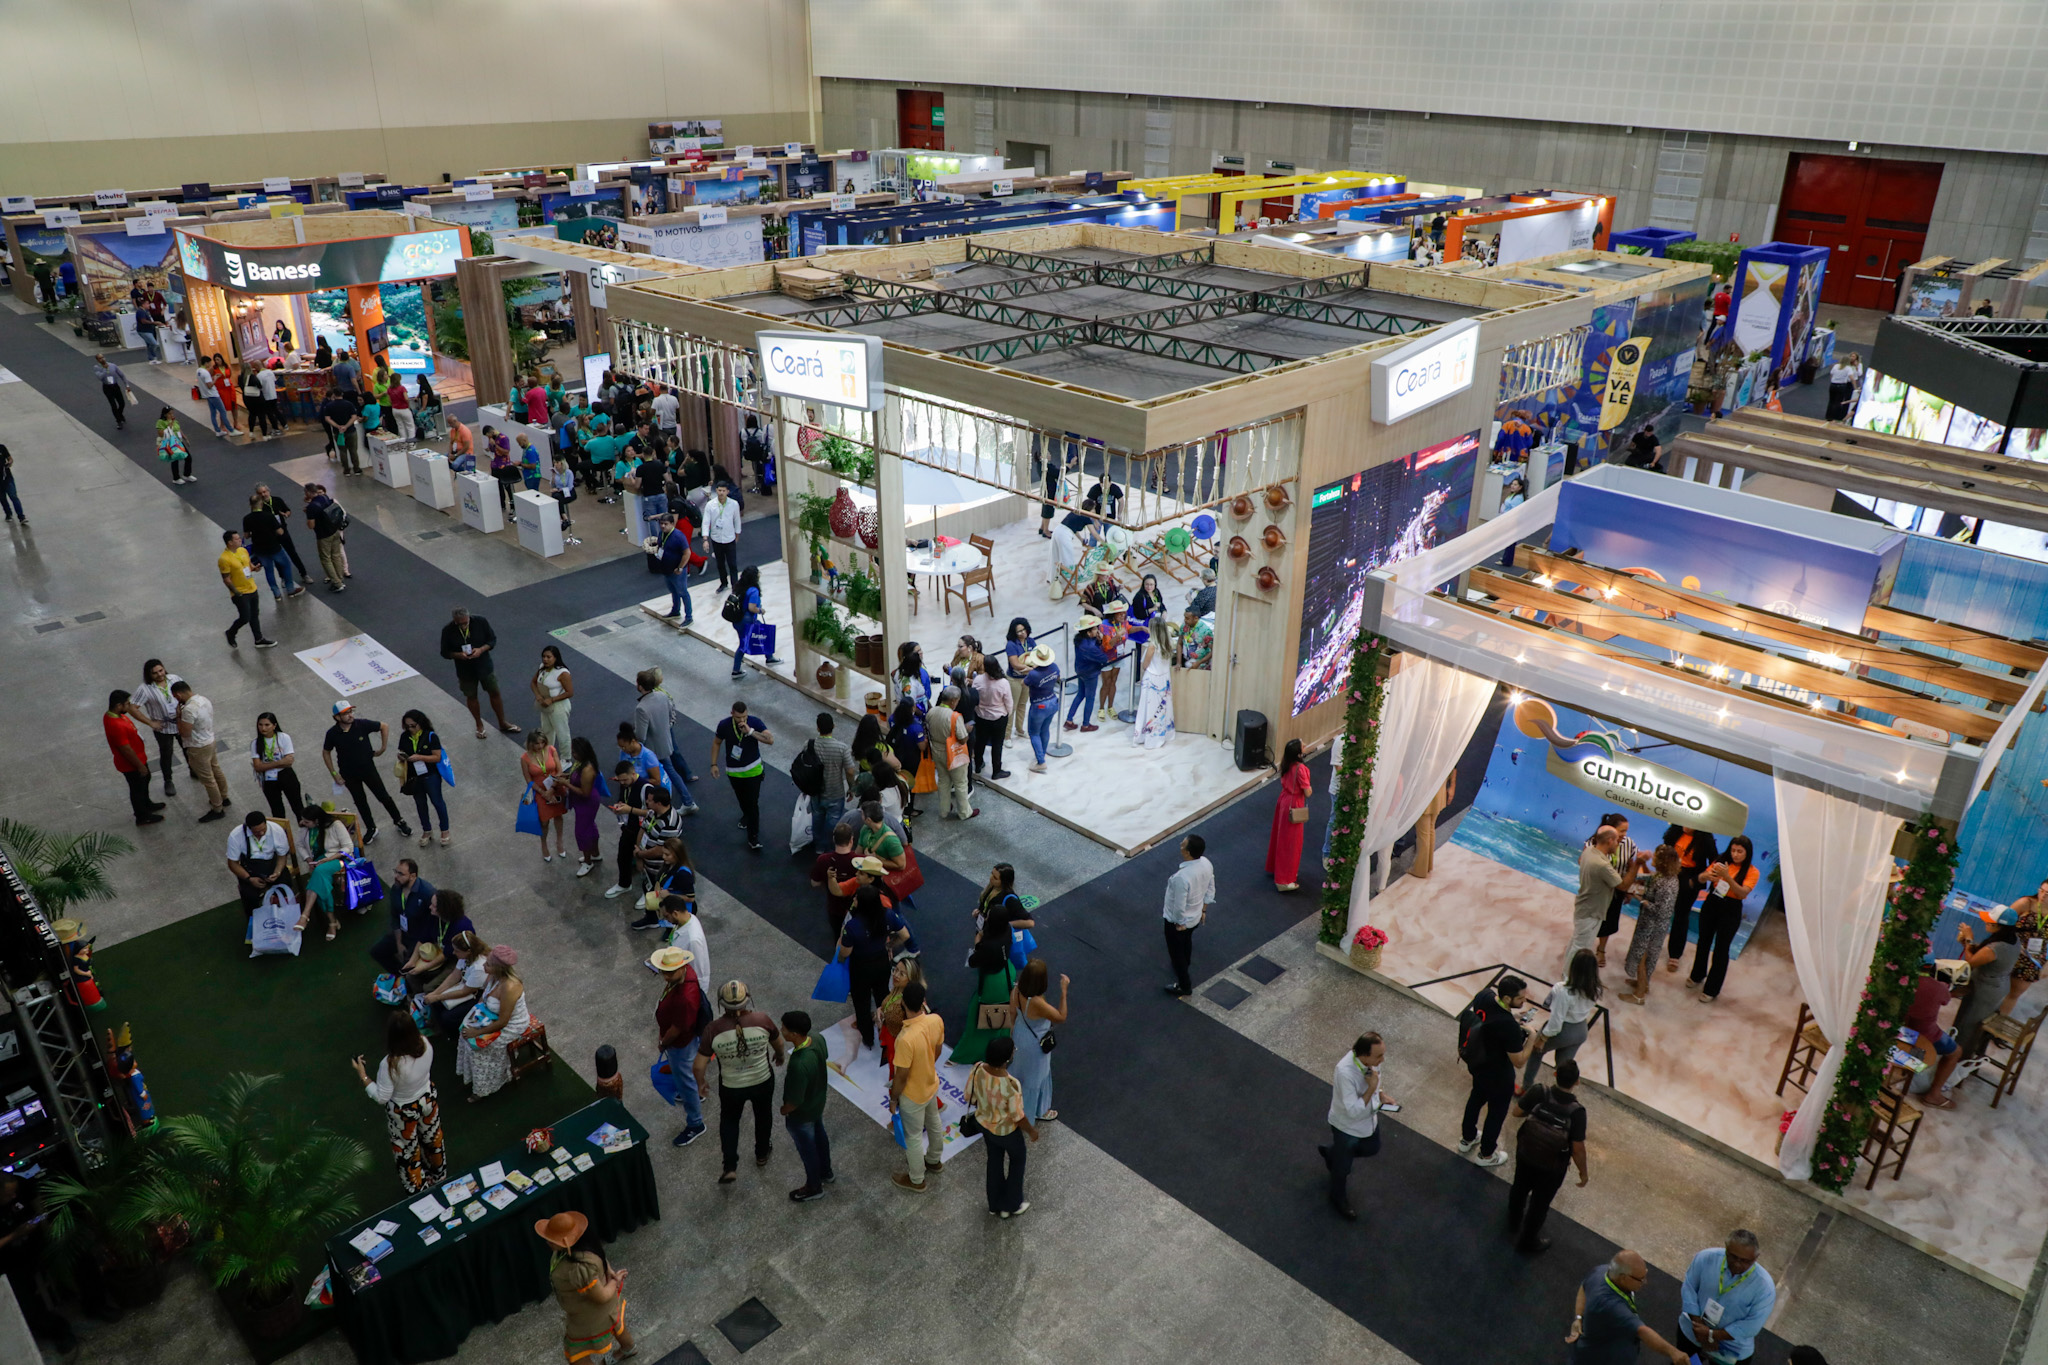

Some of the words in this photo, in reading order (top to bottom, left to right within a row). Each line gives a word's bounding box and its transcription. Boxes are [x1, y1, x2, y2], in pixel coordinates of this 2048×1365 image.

[679, 142, 697, 150] USA
[654, 230, 663, 238] 10
[665, 225, 703, 237] MOTIVOS
[246, 262, 321, 281] Banese
[771, 346, 823, 378] Ceará
[1396, 352, 1441, 397] Ceará
[1611, 379, 1631, 392] VA
[1608, 392, 1629, 405] LE
[1319, 488, 1341, 503] Fortaleza
[1740, 672, 1752, 685] A
[1757, 675, 1810, 703] MECA
[1583, 761, 1703, 811] cumbuco
[1605, 789, 1645, 810] Caucaia
[1653, 806, 1669, 818] CE
[939, 1076, 968, 1106] BRAS
